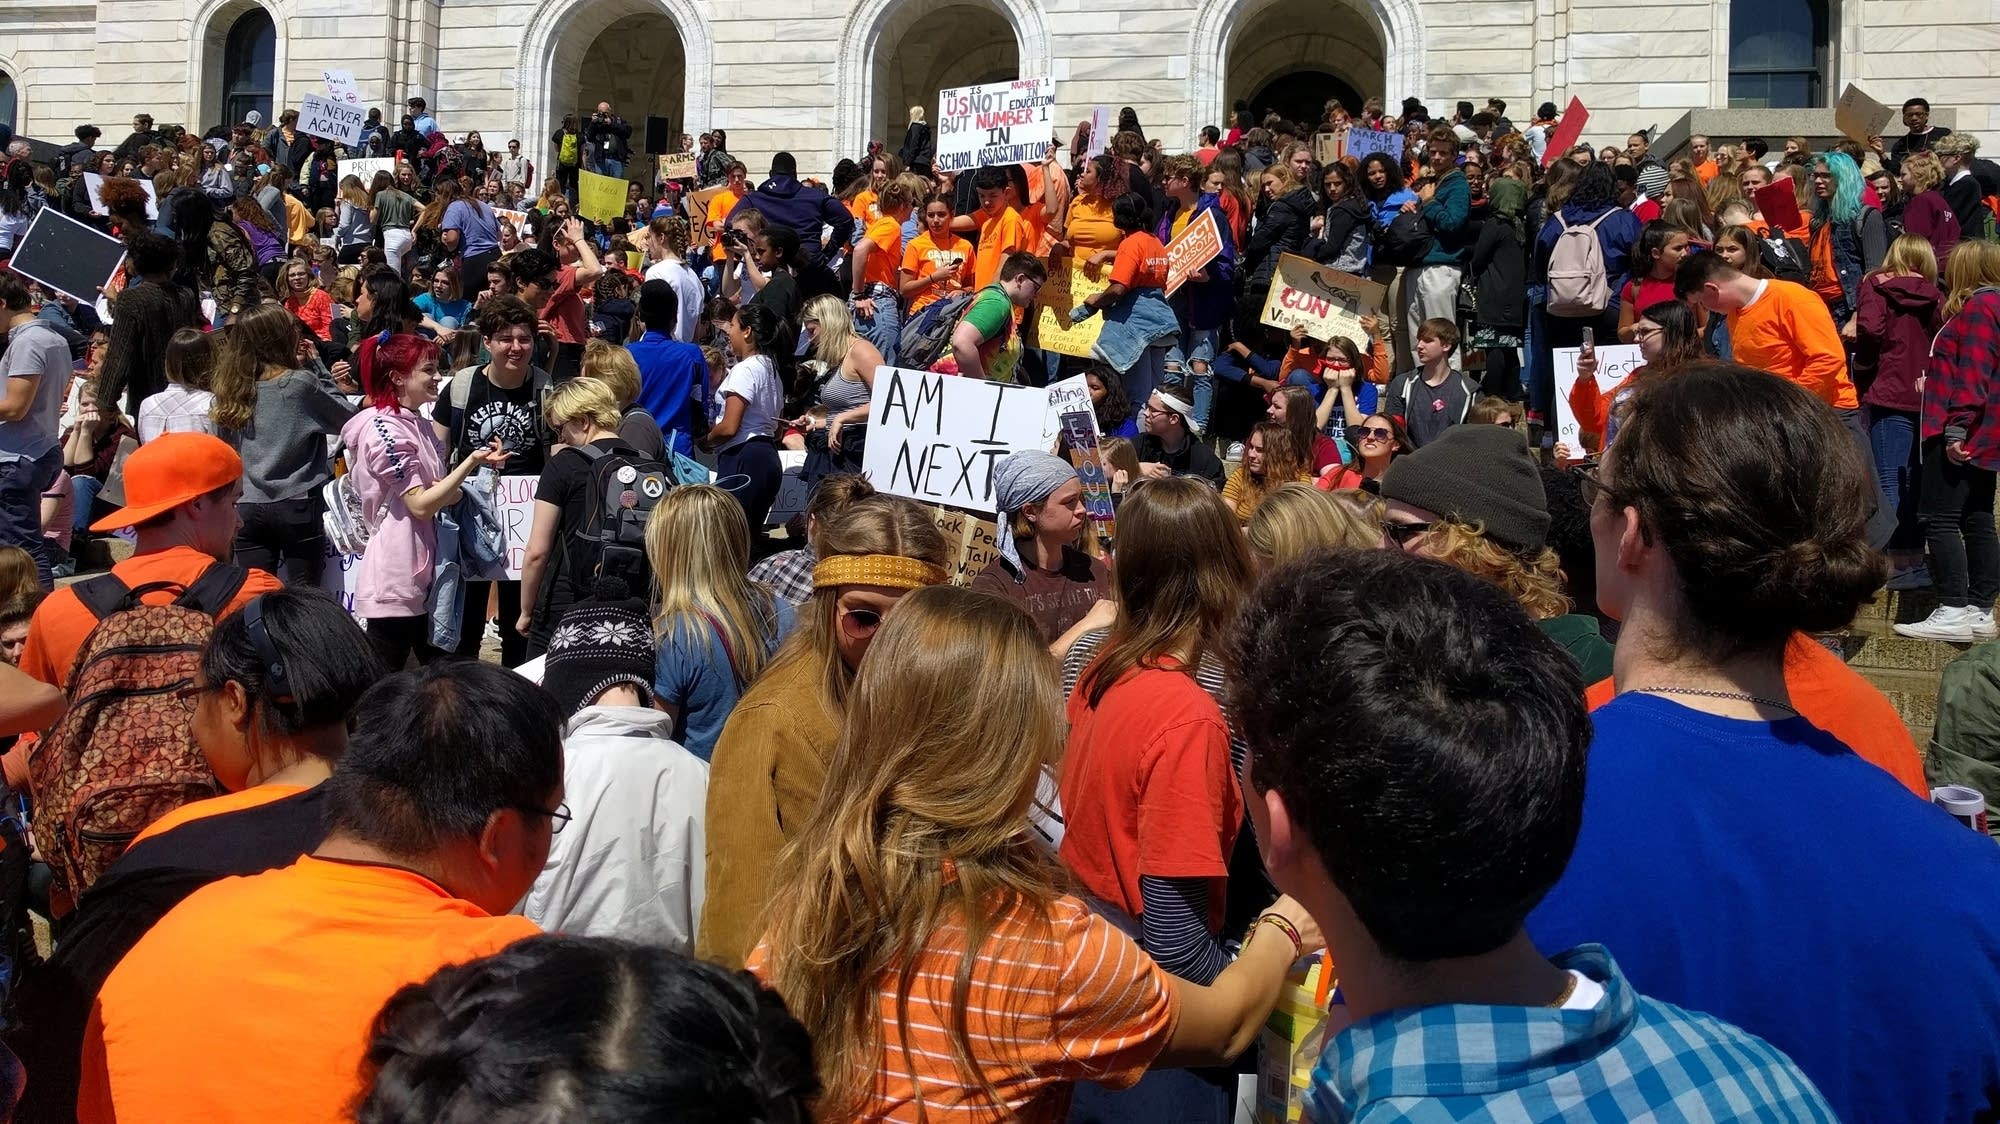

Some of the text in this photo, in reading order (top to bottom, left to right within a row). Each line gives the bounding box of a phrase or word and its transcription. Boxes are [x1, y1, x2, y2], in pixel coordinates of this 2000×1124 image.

[942, 87, 981, 98] THE IS
[1011, 79, 1040, 90] NUMBER
[1027, 88, 1038, 97] IN
[969, 91, 1009, 114] NOT
[1009, 95, 1055, 110] EDUCATION
[308, 116, 350, 138] AGAIN
[941, 107, 1048, 135] BUT NUMBER 1
[985, 127, 1010, 147] IN
[1350, 129, 1393, 144] MARCH
[1353, 140, 1395, 153] 4 OUR
[669, 152, 696, 164] ARMS
[939, 141, 1051, 171] SCHOOL ASSASSINATION
[352, 160, 381, 173] PRESS
[1167, 218, 1210, 262] ROTECT
[1280, 286, 1331, 319] GUN
[1053, 341, 1081, 353] COLOR
[470, 401, 504, 425] KEEP
[881, 369, 1026, 446] AM I
[890, 438, 1011, 502] NEXT
[1068, 417, 1108, 538] ENOUGH
[966, 545, 999, 564] Talk
